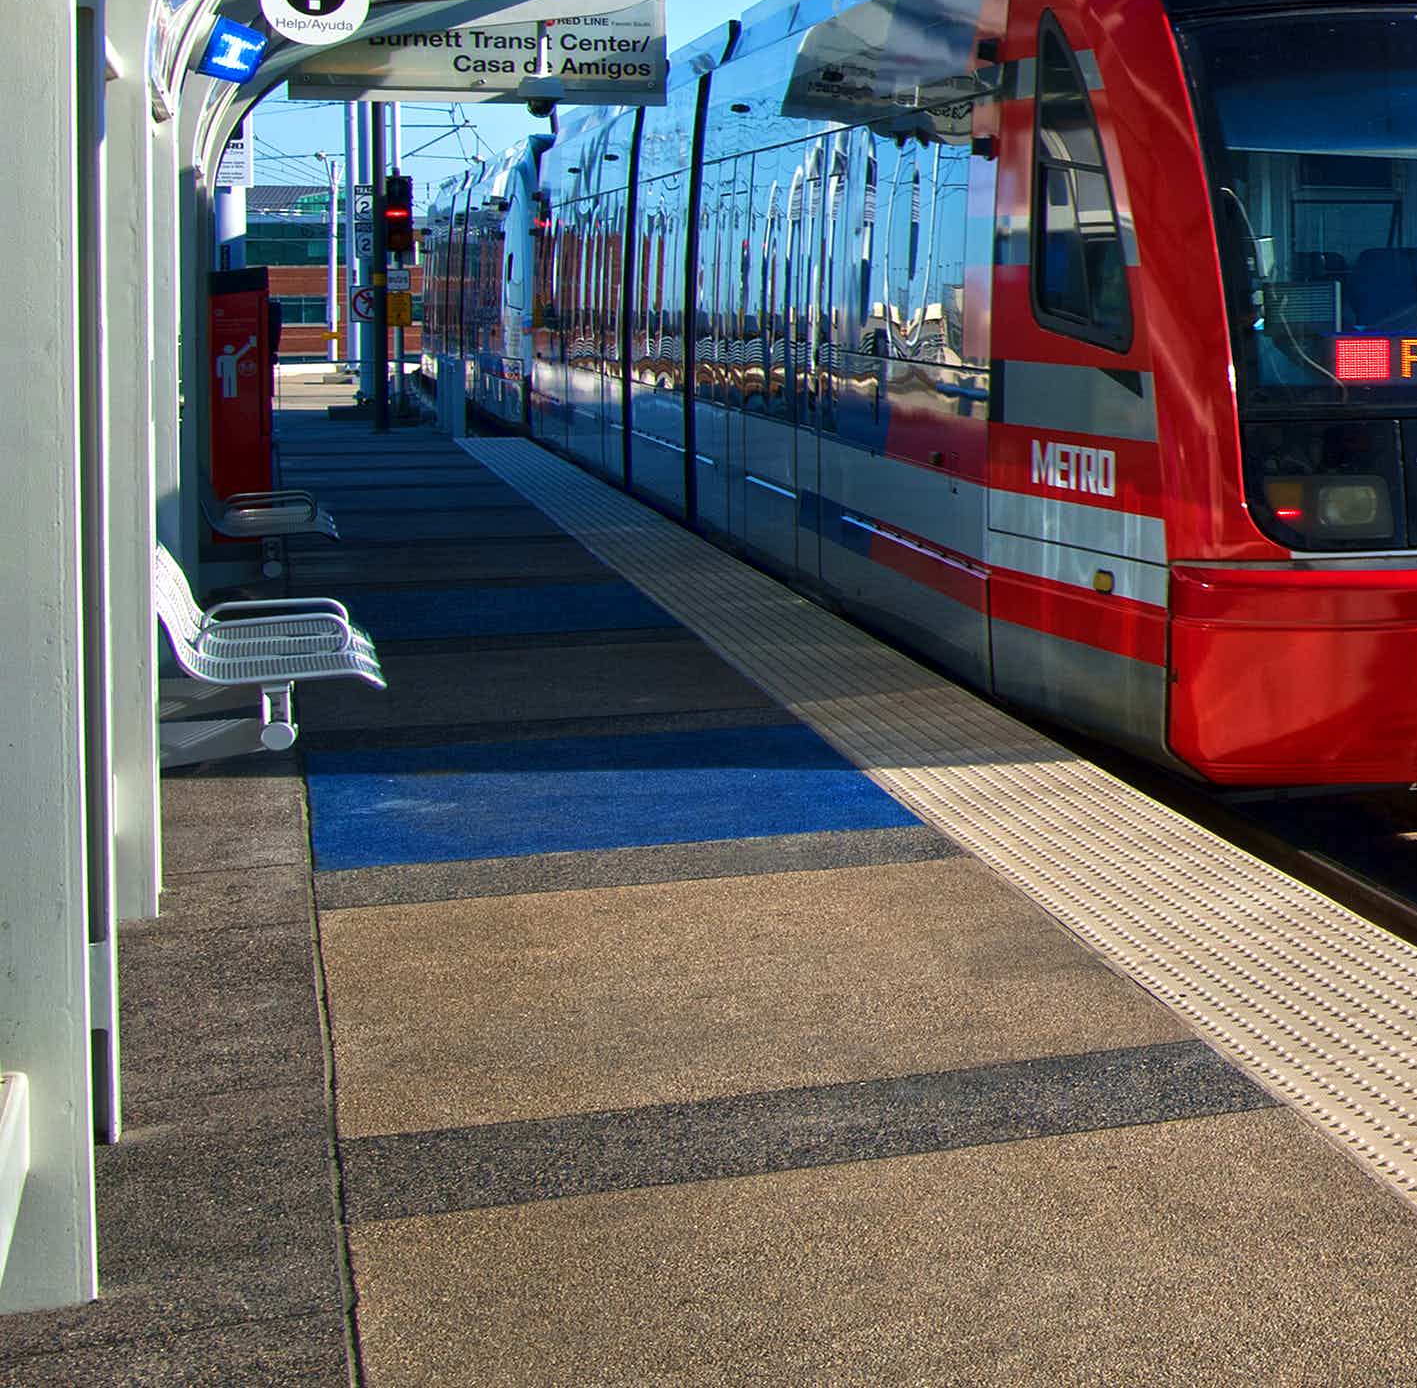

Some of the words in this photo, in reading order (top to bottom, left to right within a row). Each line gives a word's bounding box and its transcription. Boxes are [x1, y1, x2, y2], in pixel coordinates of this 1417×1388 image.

[275, 17, 353, 33] Help/Ayuda
[557, 17, 581, 26] RED
[583, 17, 609, 27] LINE
[469, 31, 552, 50] Transt
[560, 33, 650, 53] Center/
[453, 54, 515, 73] Casa
[561, 57, 651, 79] Amigos
[360, 201, 370, 213] 2
[361, 238, 371, 251] 2
[1031, 439, 1116, 498] METRO
